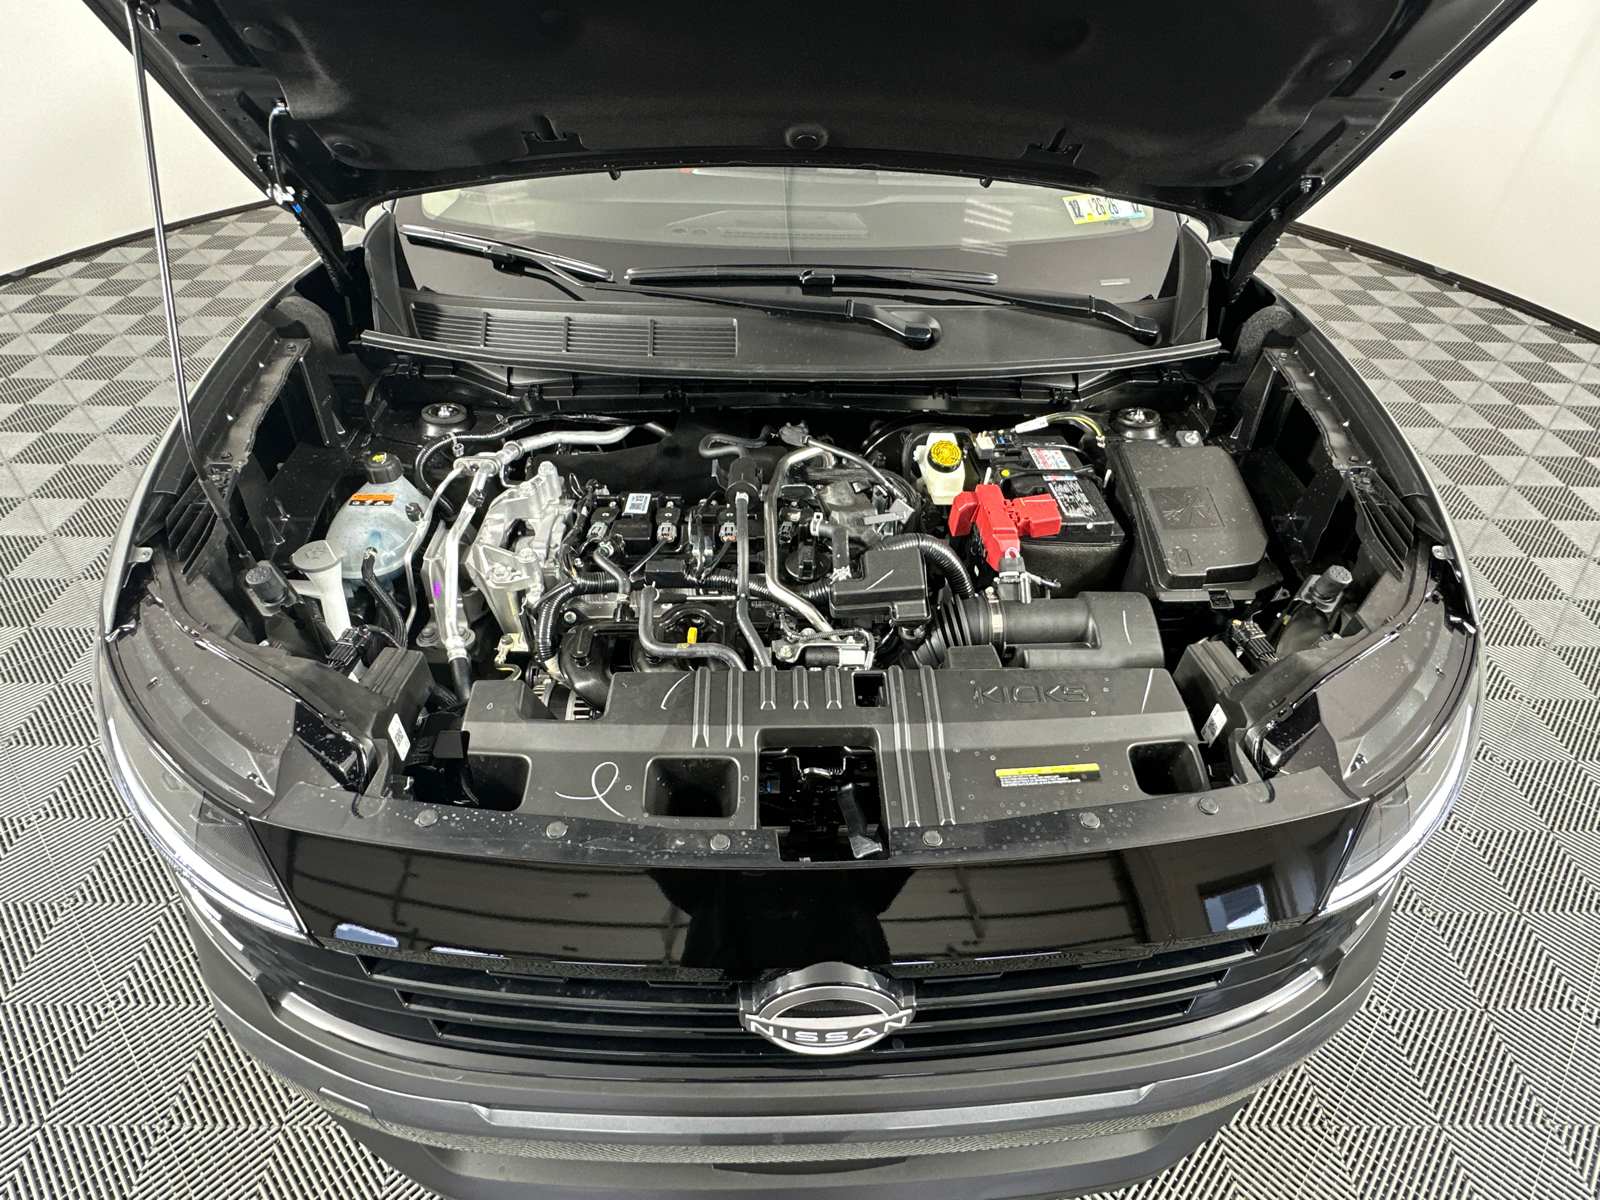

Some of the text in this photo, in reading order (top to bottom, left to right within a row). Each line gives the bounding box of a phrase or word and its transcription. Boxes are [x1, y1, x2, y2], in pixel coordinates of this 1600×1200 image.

[1068, 197, 1107, 218] 12 26
[1105, 197, 1119, 215] 26
[975, 684, 1090, 704] KICKS
[750, 1016, 907, 1042] NISSAN
